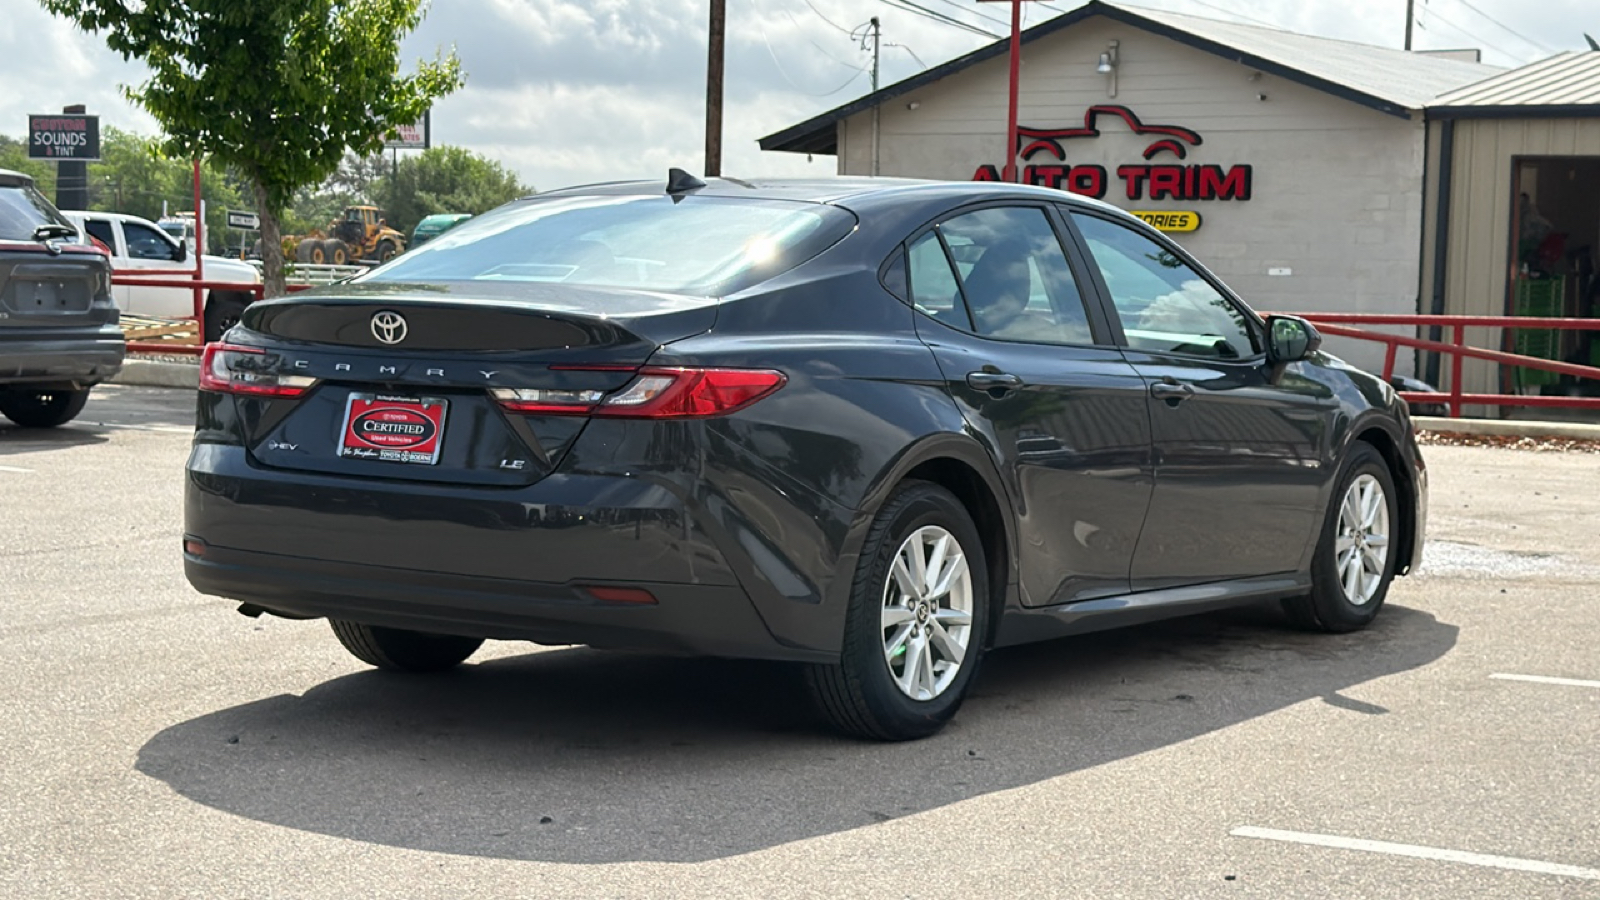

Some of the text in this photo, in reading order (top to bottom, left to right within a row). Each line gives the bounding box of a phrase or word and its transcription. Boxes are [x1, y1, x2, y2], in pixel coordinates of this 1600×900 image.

[33, 119, 86, 130] CUSTOM
[34, 132, 87, 146] SOUNDS
[55, 146, 75, 156] TINT
[1117, 164, 1252, 200] TRIM
[295, 360, 499, 379] CAMRY
[363, 420, 425, 435] CERTIFIED
[500, 459, 525, 469] LE
